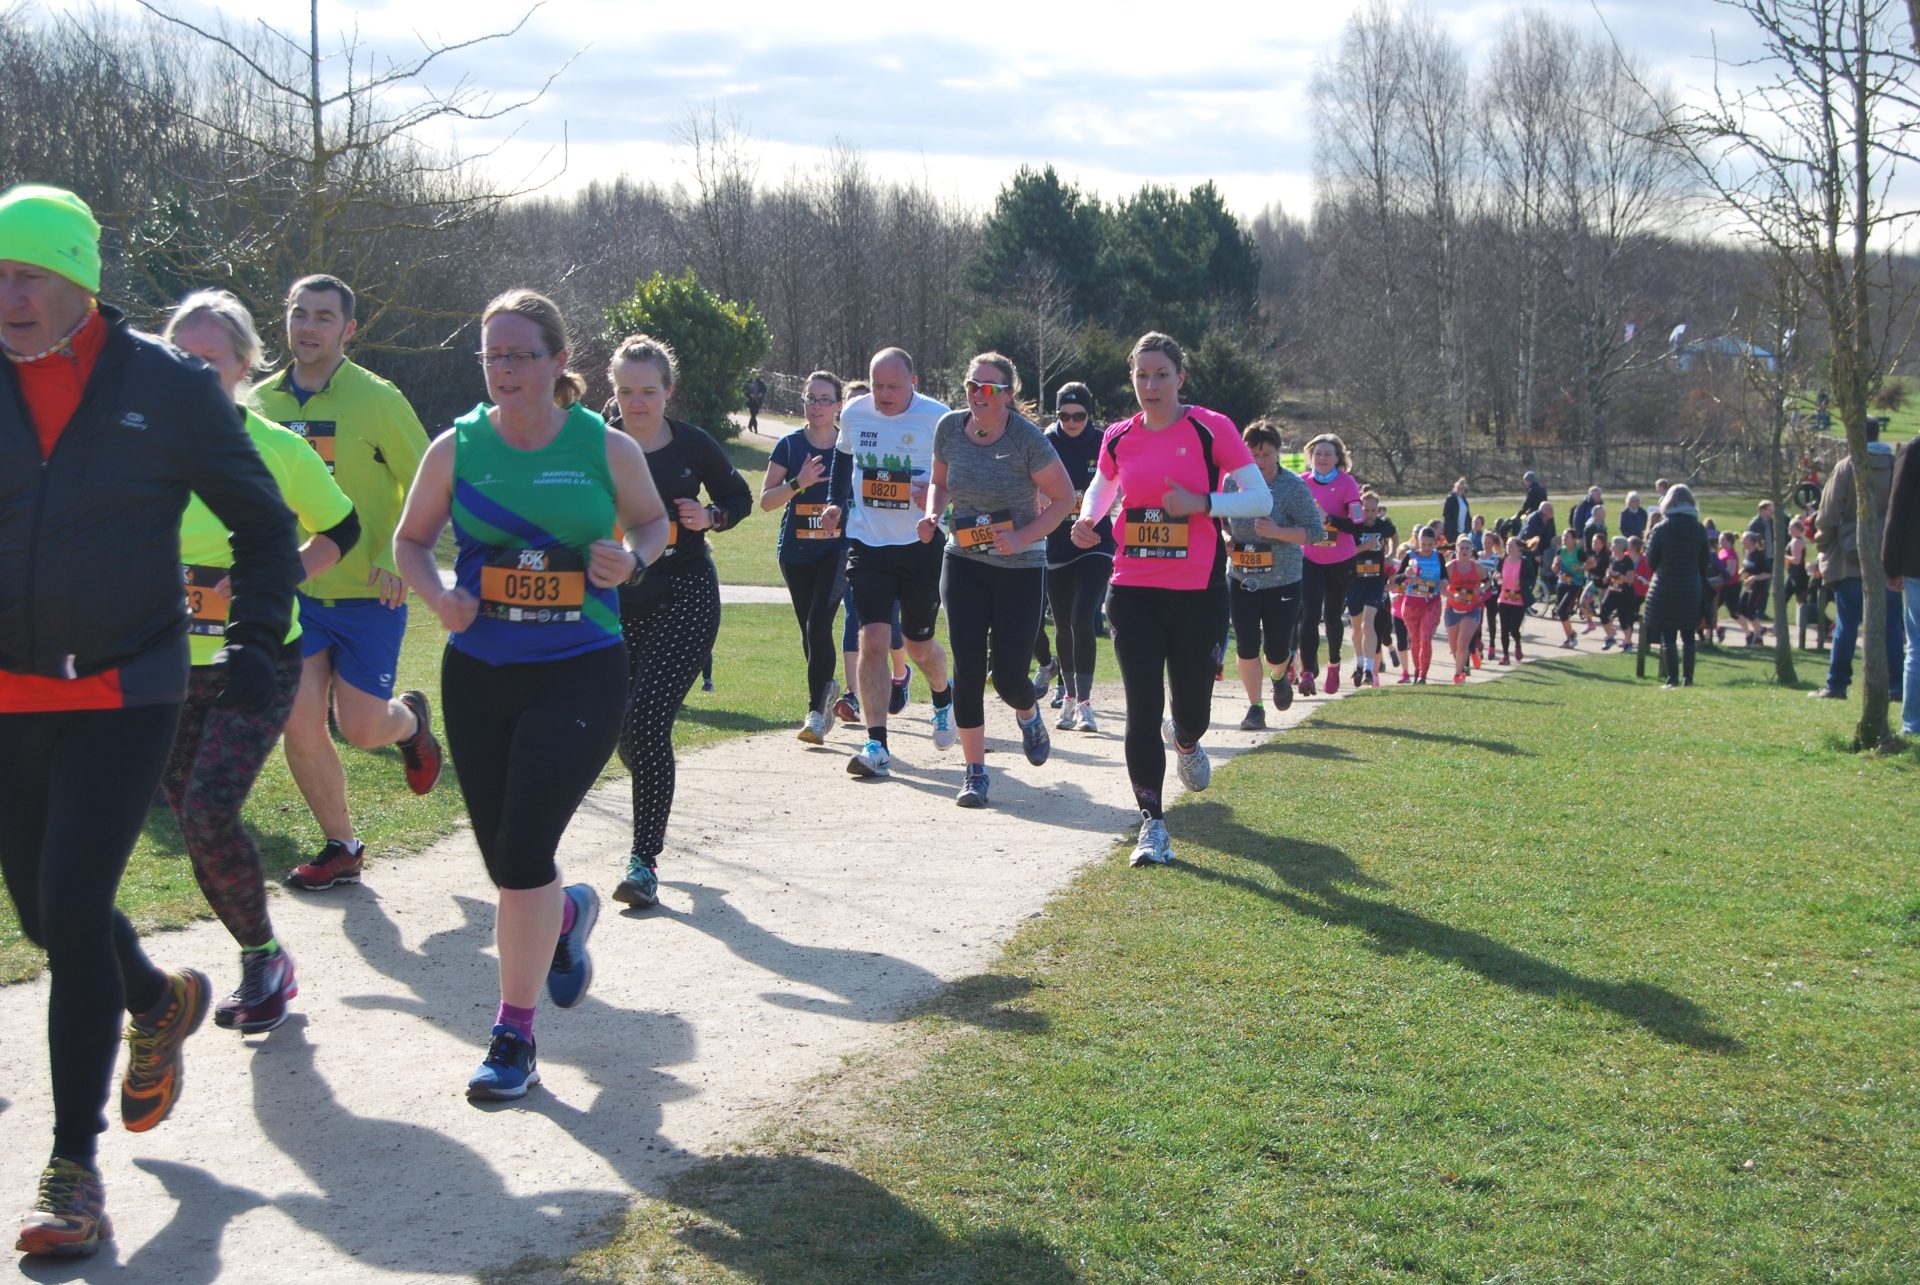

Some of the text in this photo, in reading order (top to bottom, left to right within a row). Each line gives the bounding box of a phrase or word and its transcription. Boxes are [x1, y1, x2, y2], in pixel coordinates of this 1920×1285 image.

[871, 483, 897, 497] 0820
[808, 516, 823, 529] 110
[971, 527, 993, 542] 066
[1138, 526, 1170, 543] 0143
[1240, 554, 1262, 565] 0288
[505, 574, 560, 601] 0583
